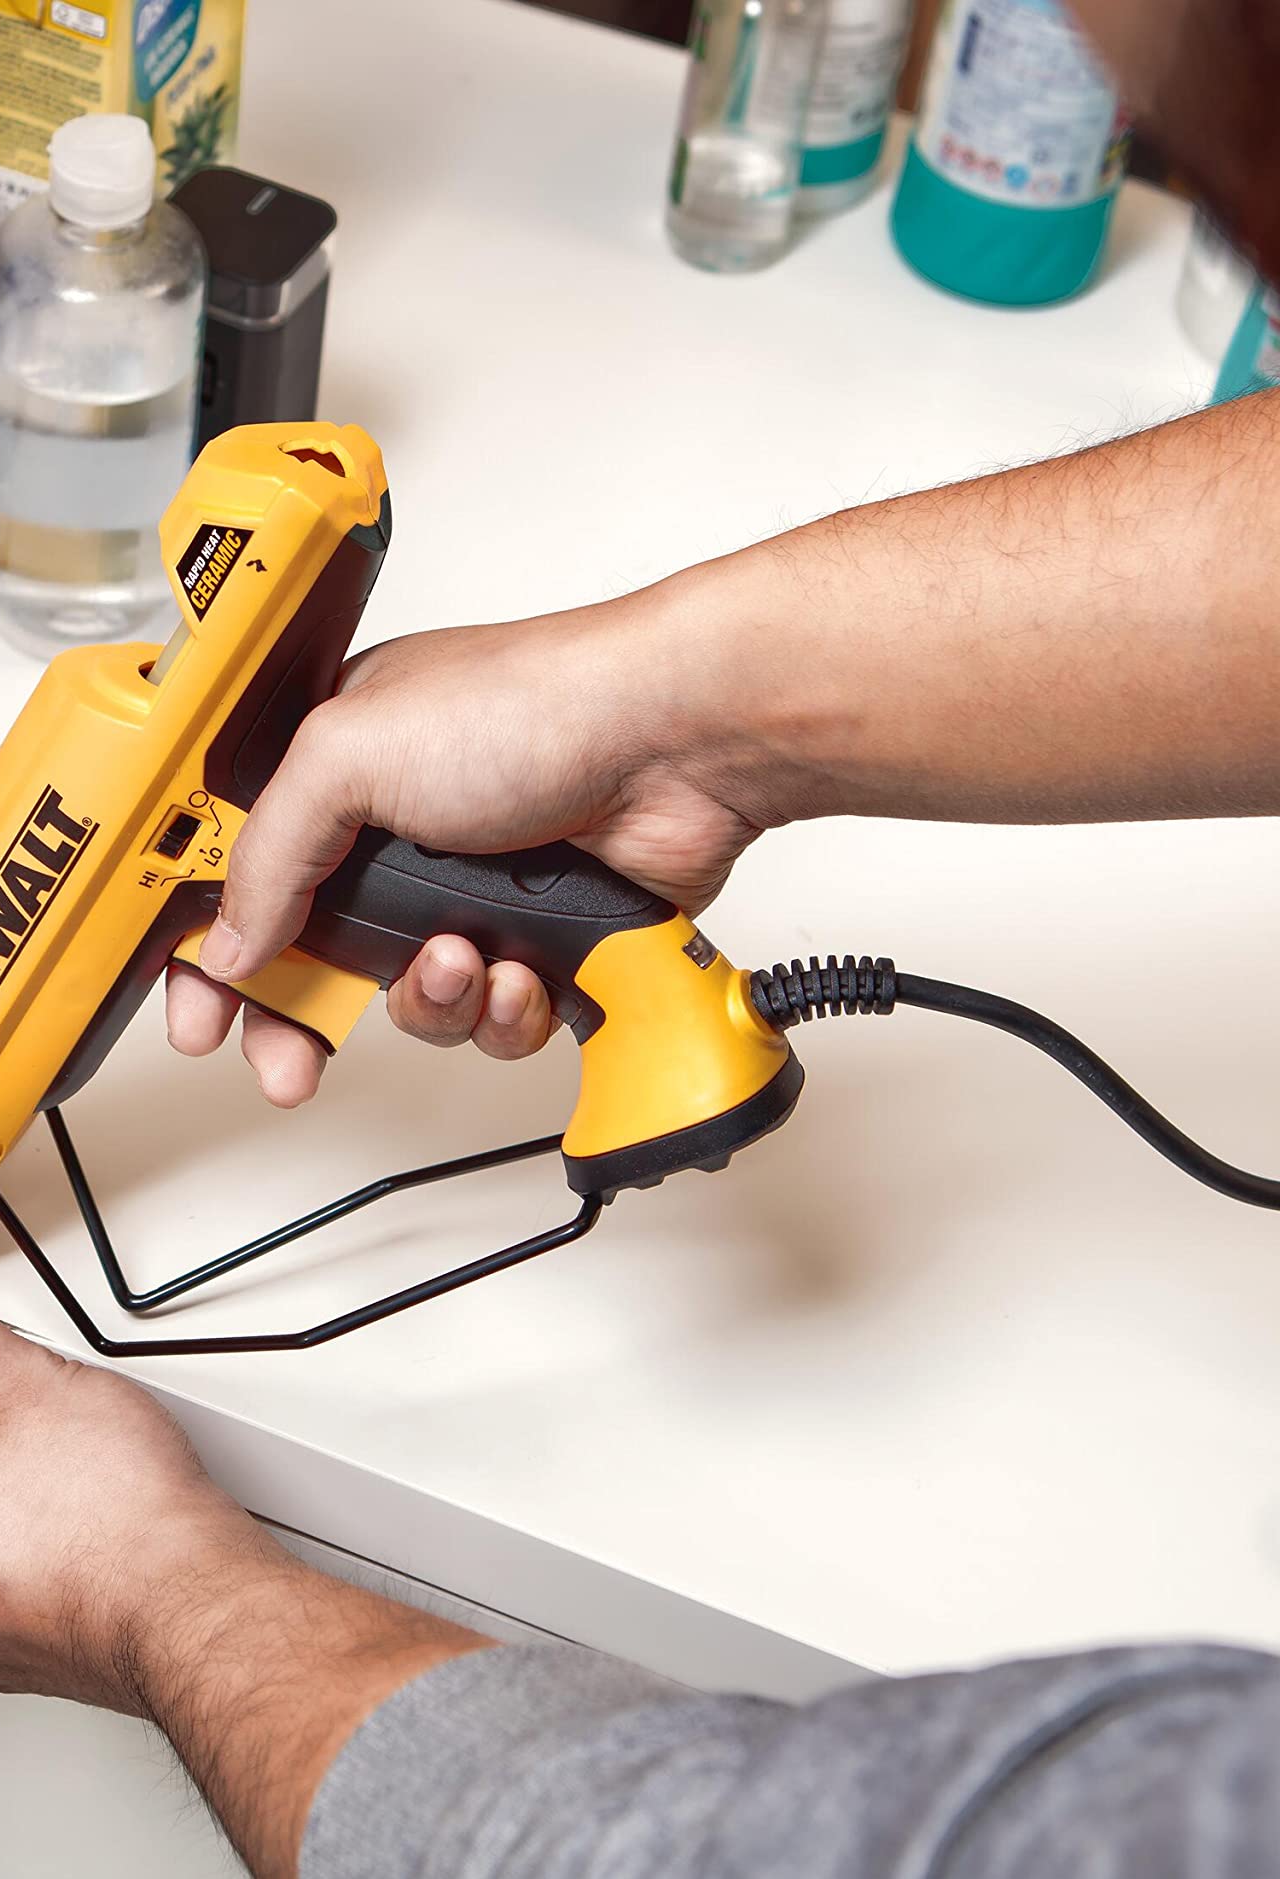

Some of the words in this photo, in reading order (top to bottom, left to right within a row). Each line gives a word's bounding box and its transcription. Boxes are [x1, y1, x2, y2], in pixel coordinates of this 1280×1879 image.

[183, 556, 206, 589] RAPID
[200, 528, 221, 560] HEAT
[190, 529, 242, 610] CERAMIC
[203, 847, 224, 867] LO
[138, 870, 160, 889] HI
